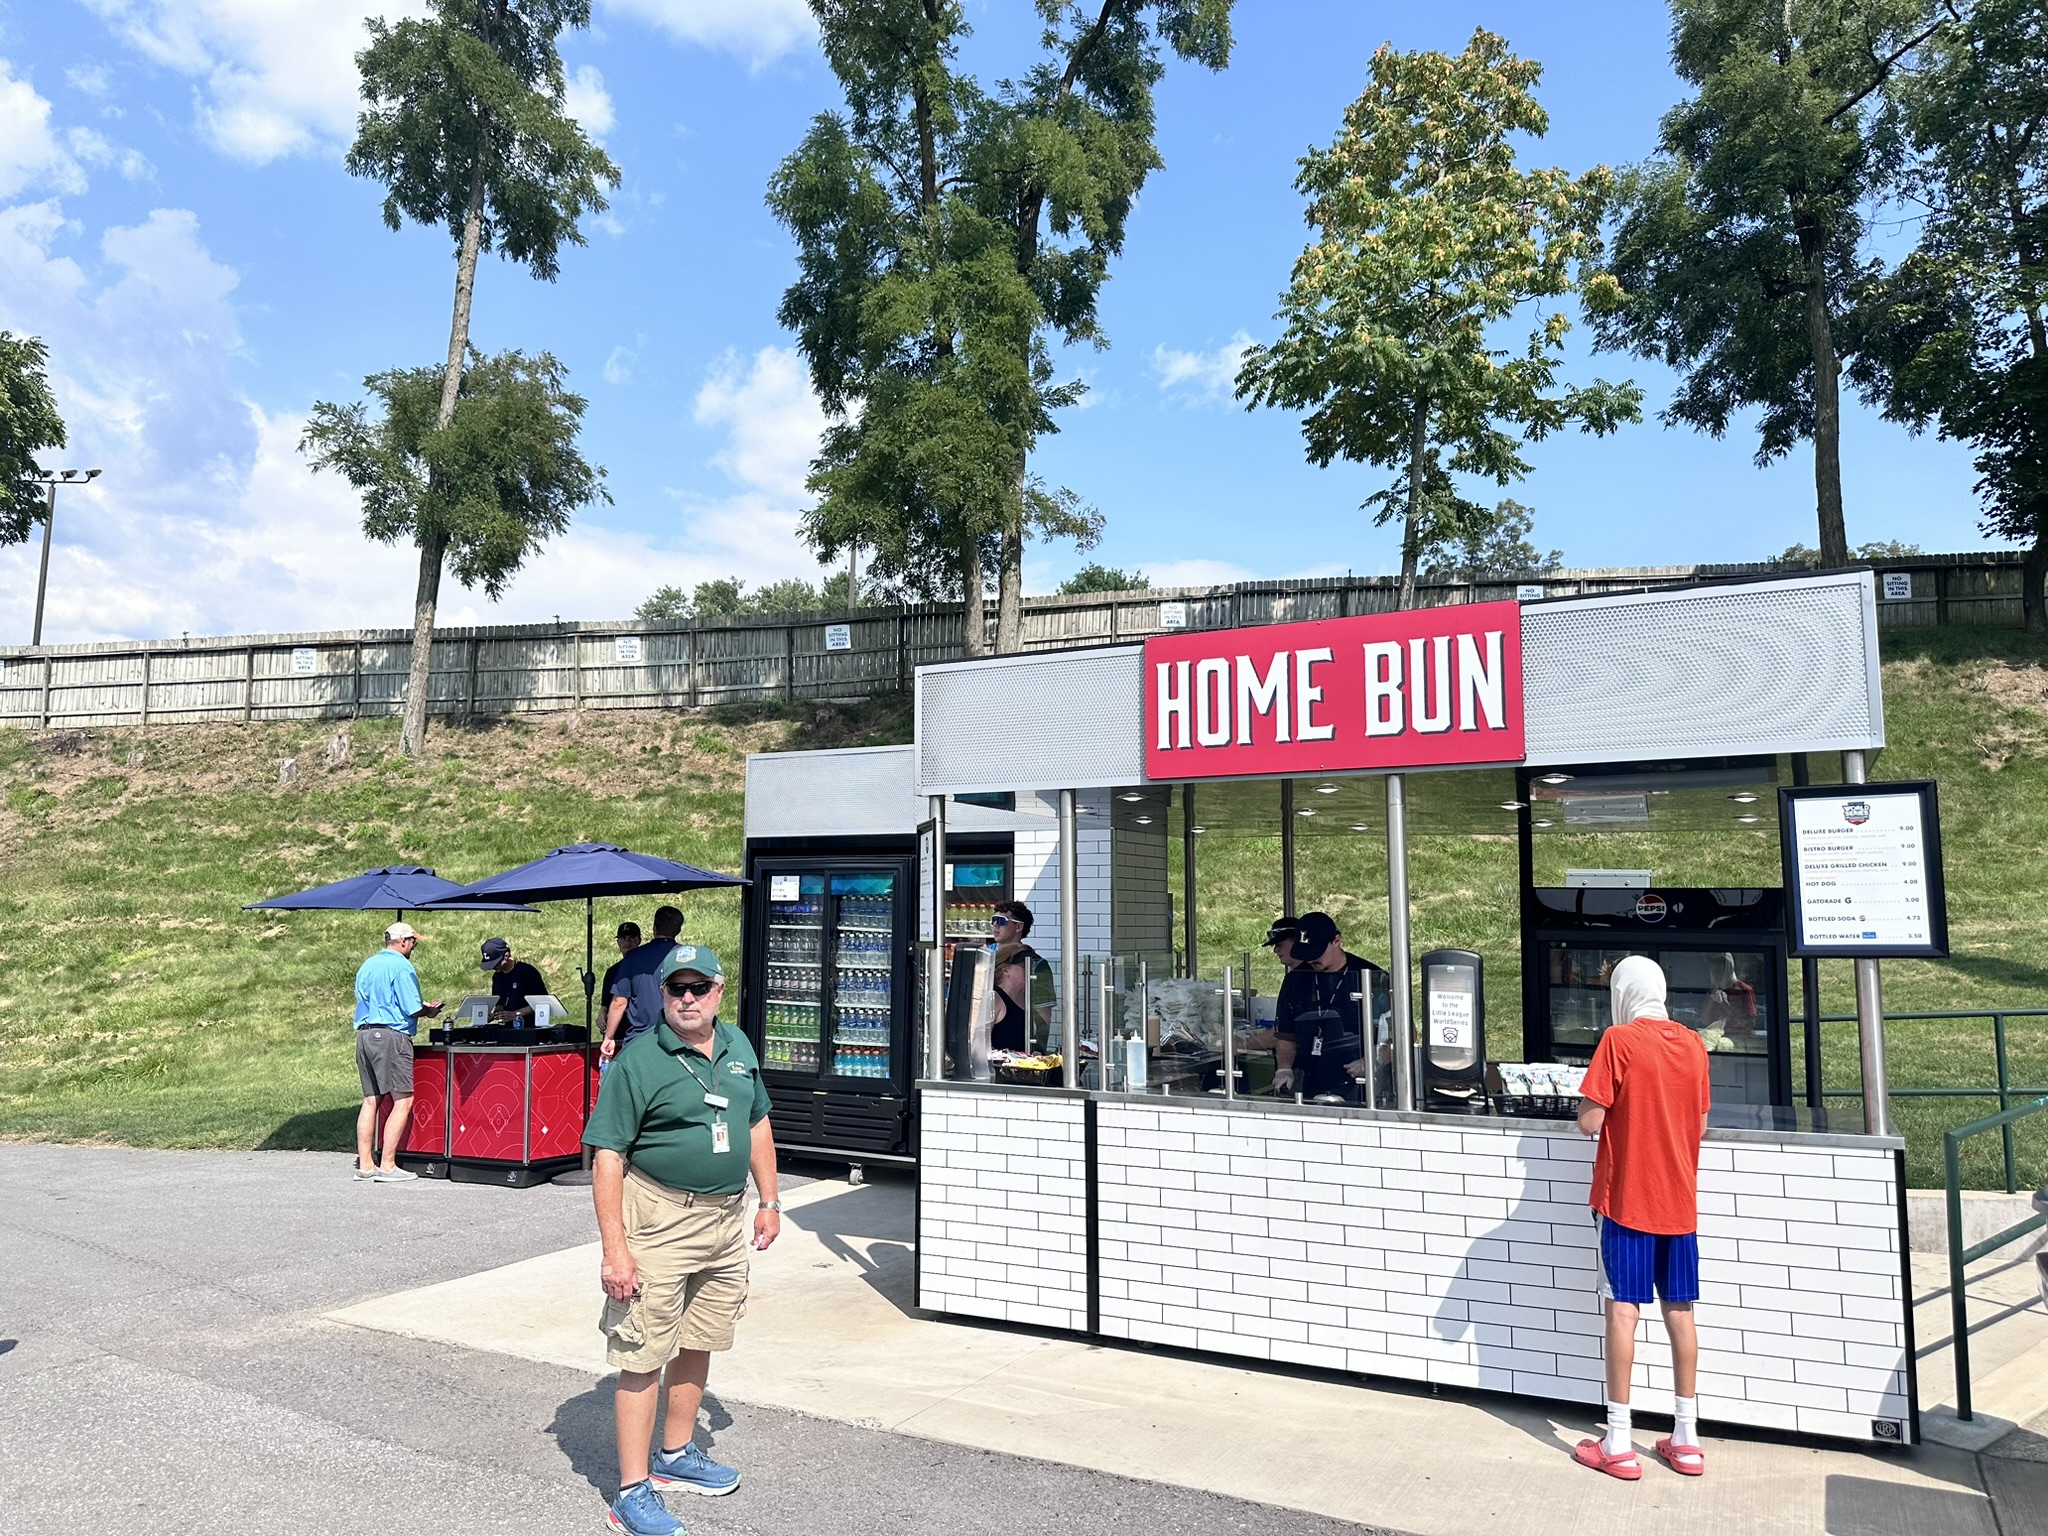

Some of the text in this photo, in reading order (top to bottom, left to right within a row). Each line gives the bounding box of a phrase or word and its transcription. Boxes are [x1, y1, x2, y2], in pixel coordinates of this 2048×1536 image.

[1156, 630, 1509, 751] HOME BUN
[1299, 930, 1310, 944] L
